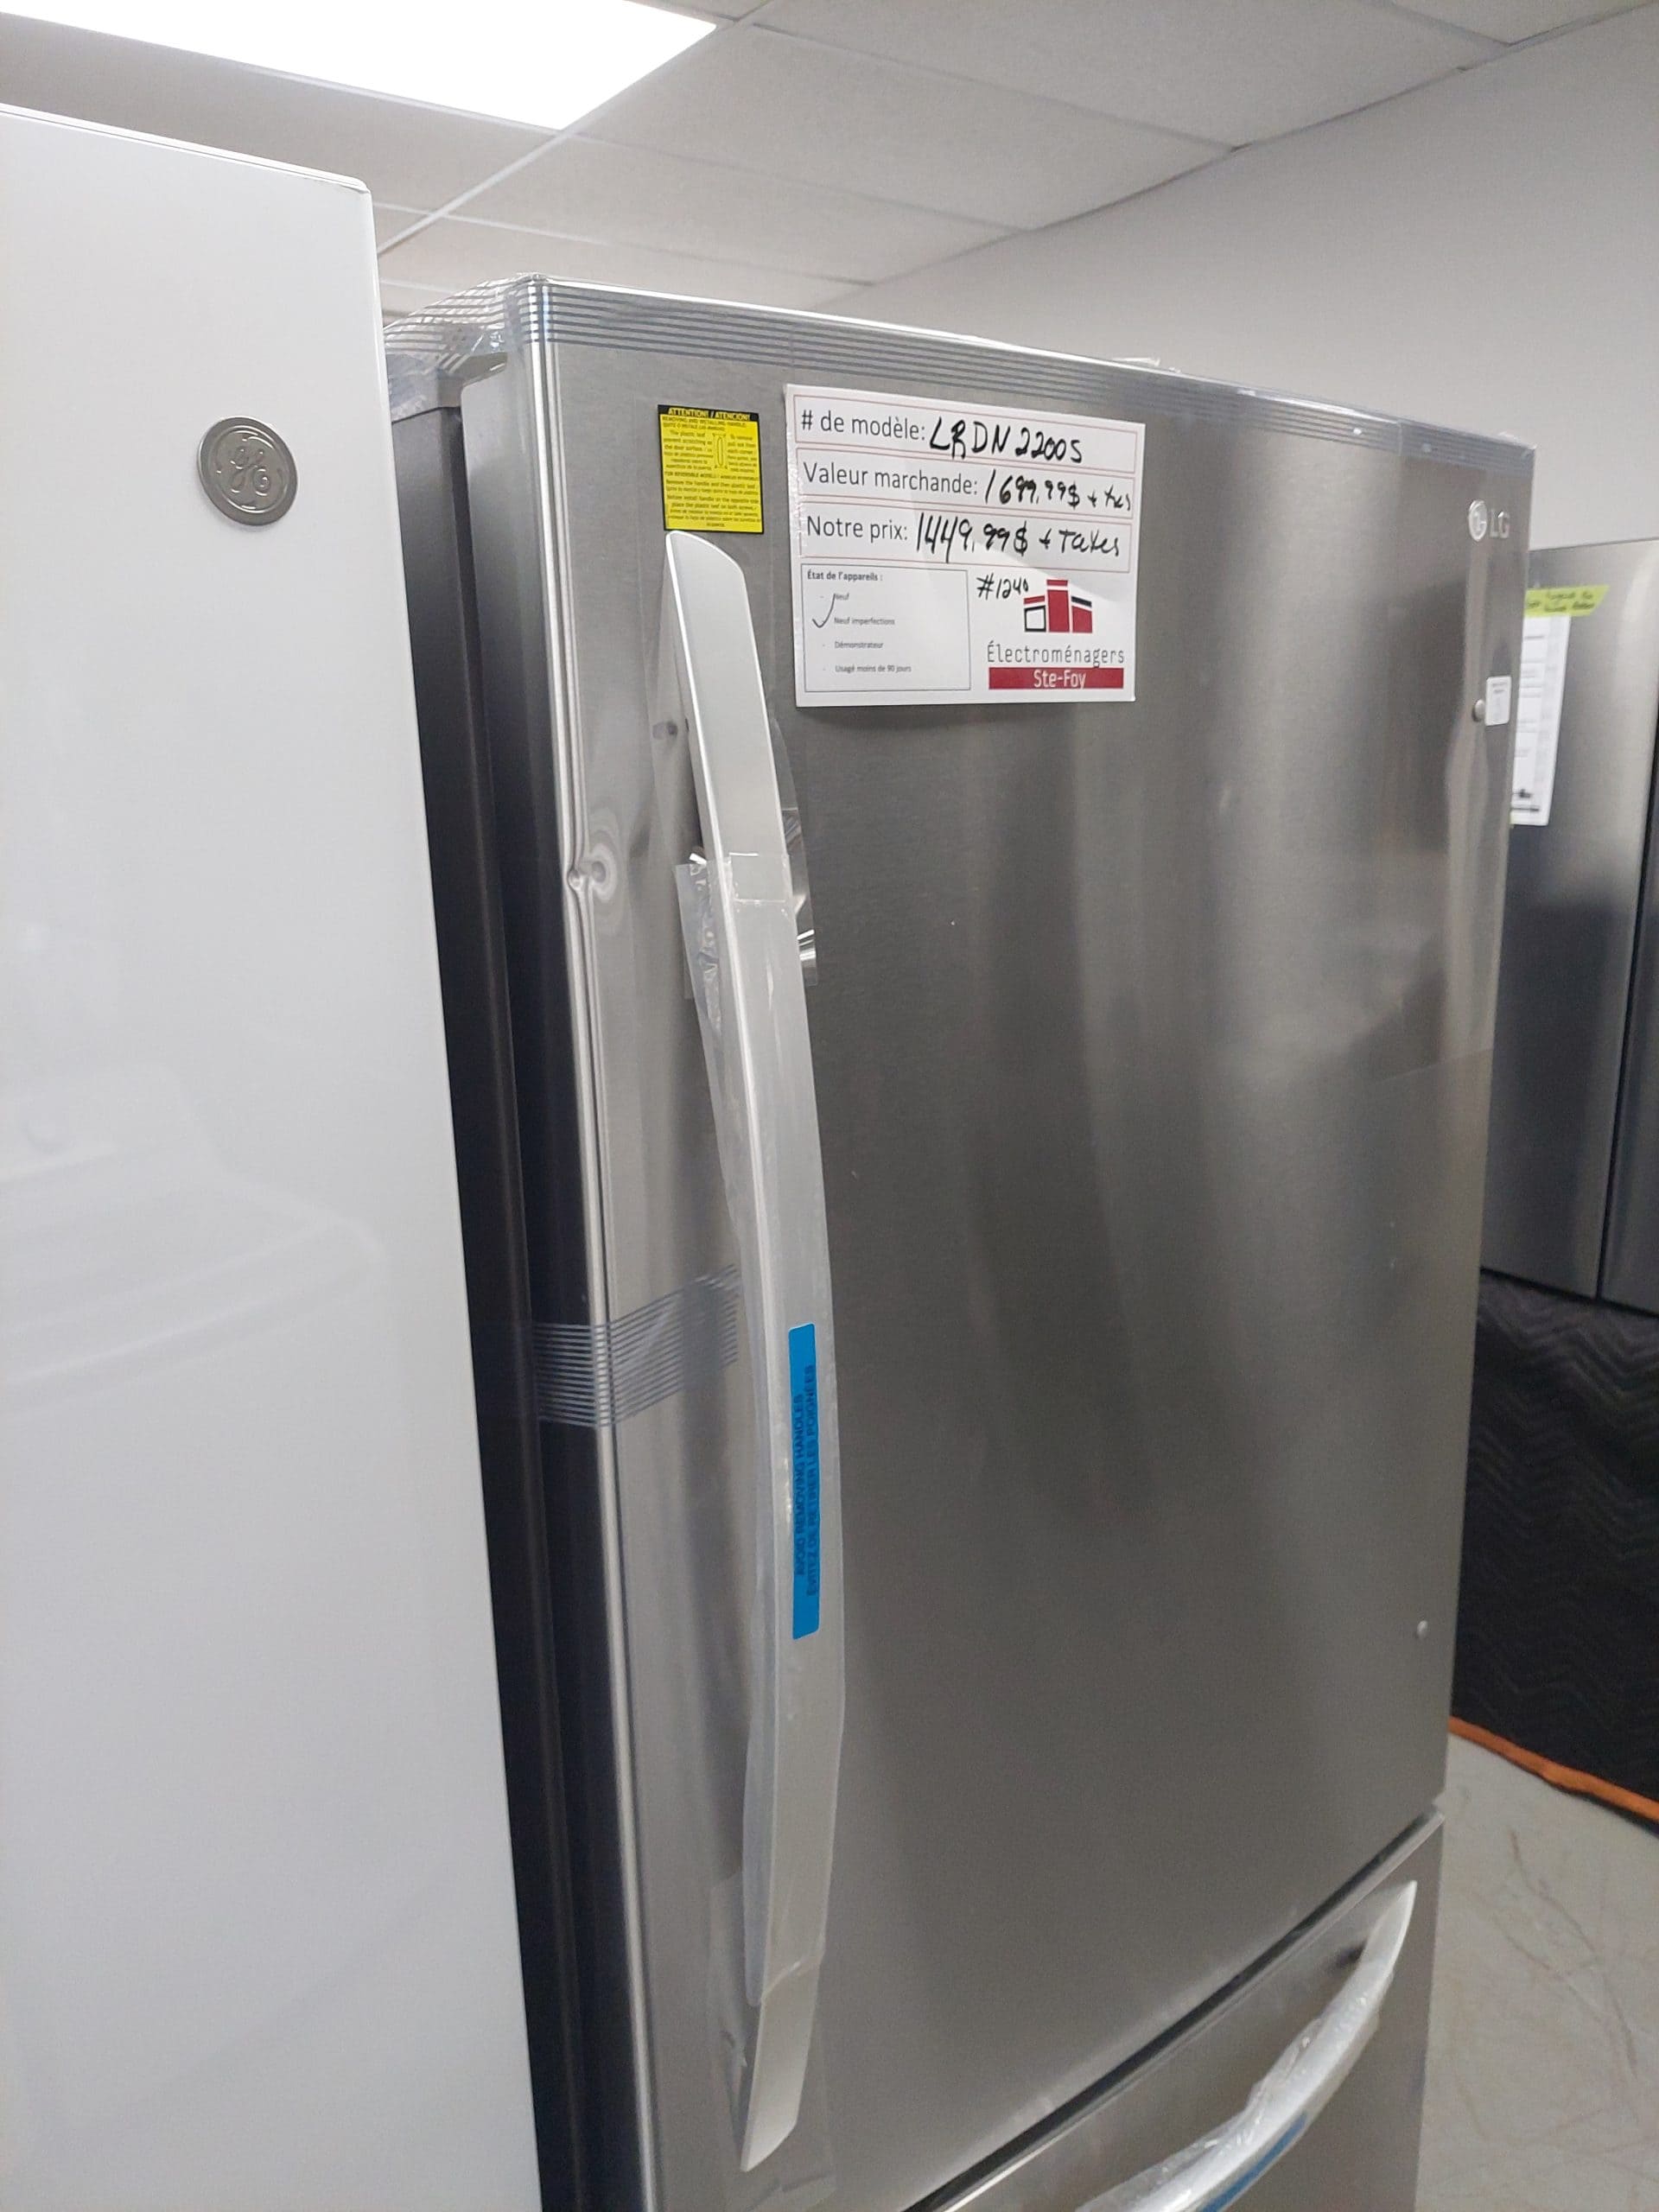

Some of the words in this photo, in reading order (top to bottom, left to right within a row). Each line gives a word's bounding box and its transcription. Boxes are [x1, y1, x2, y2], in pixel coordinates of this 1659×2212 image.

[801, 410, 813, 431] #
[821, 410, 844, 433] de
[852, 416, 925, 441] modèle:
[804, 461, 868, 486] Valeur
[874, 468, 978, 495] marchande:
[807, 515, 863, 537] Notre
[870, 519, 907, 543] prix:
[1490, 508, 1510, 538] LG
[807, 569, 823, 580] État
[826, 571, 836, 581] de
[988, 640, 1124, 668] Électroménagers
[1033, 669, 1087, 689] Ste-Foy
